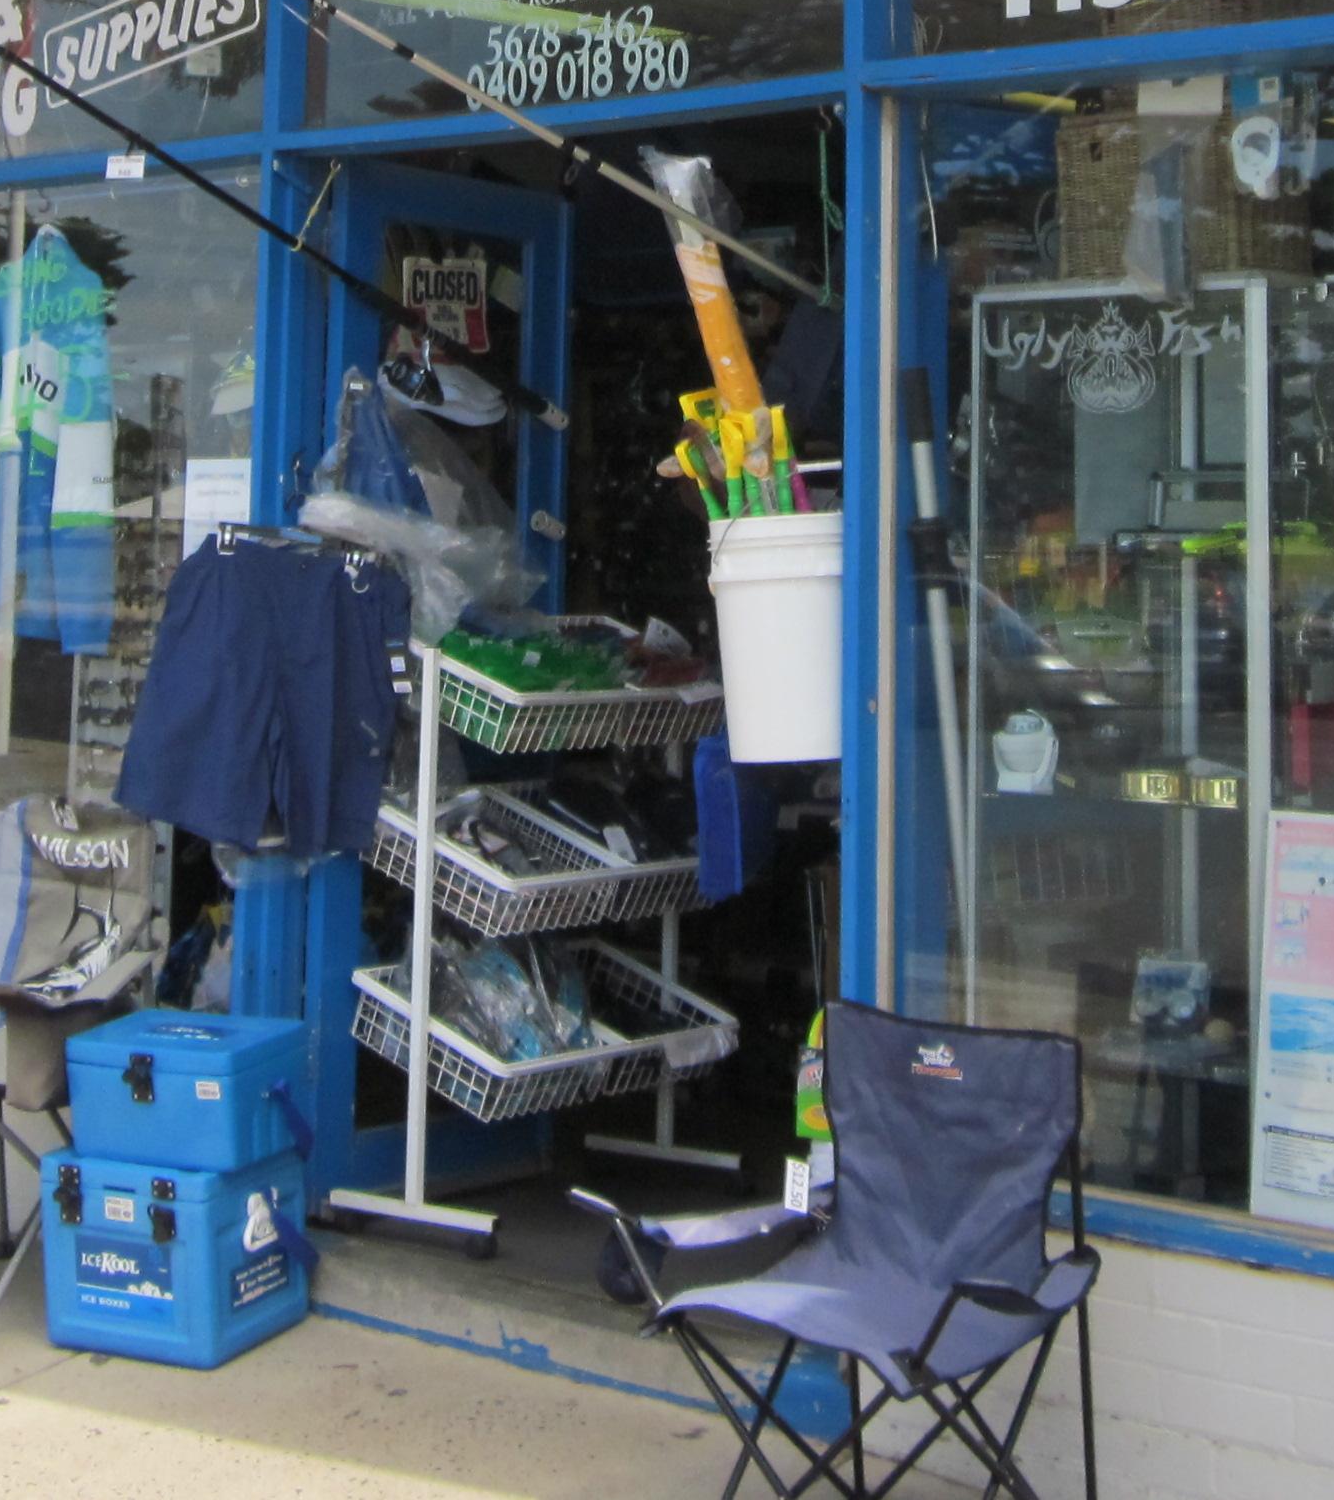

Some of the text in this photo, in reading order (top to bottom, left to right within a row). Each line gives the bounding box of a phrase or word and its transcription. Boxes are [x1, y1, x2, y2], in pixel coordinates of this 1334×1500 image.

[486, 5, 654, 65] 5678 5462
[466, 38, 689, 111] 0409 018 980
[412, 269, 478, 305] CLOSED
[982, 318, 1072, 370] Ugly
[31, 834, 129, 868] WILSON
[790, 1161, 805, 1209] $12.50
